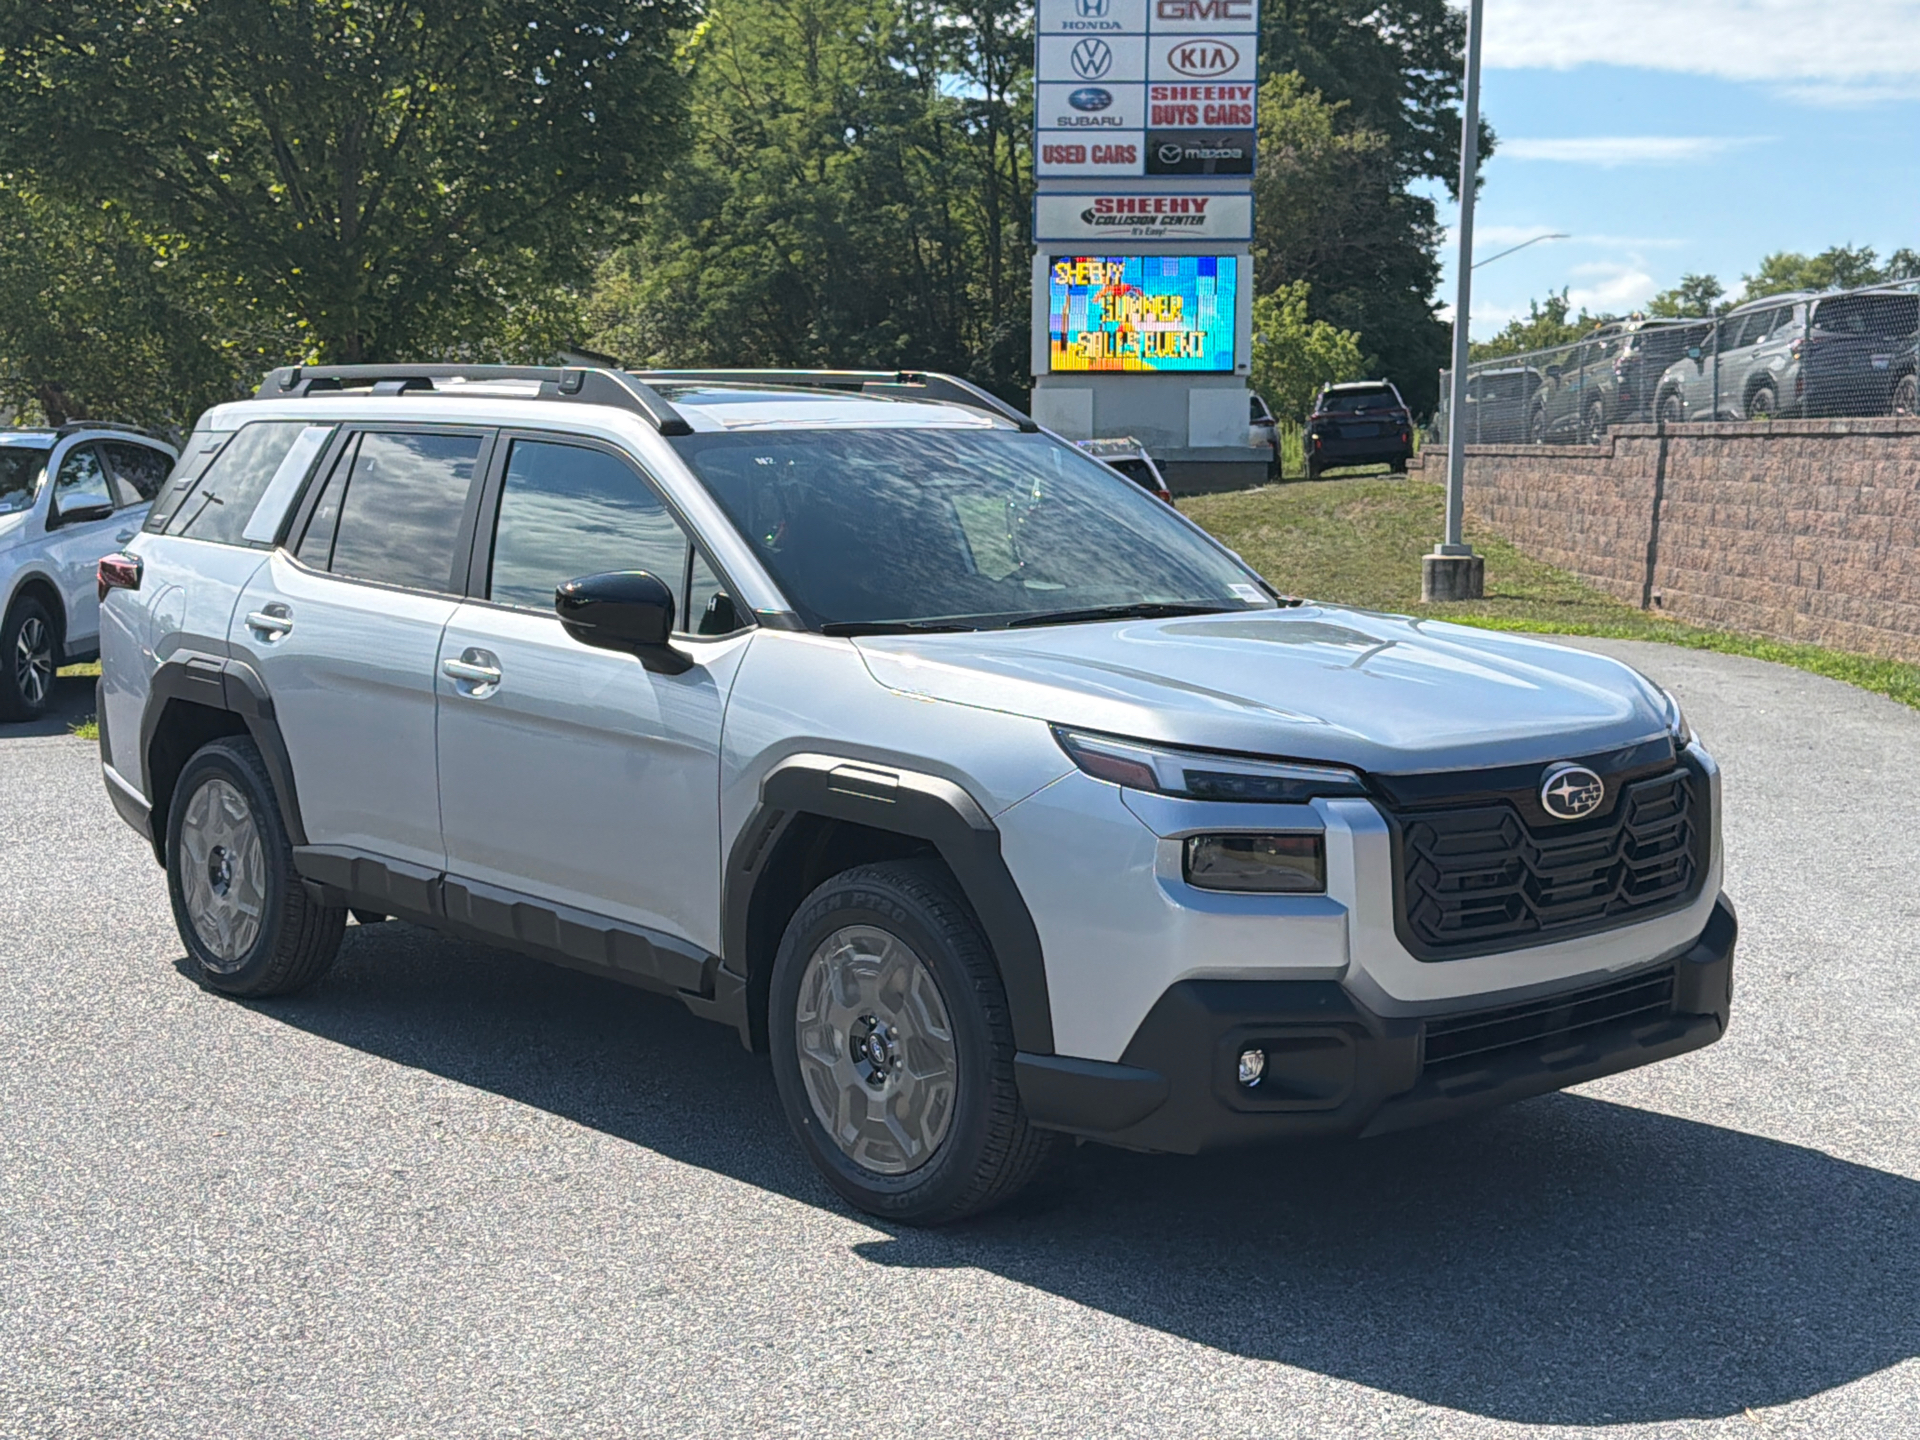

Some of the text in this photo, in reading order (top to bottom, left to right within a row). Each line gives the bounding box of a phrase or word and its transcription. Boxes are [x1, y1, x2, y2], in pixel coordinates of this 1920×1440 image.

[1157, 0, 1252, 20] GMC
[1062, 21, 1122, 30] HONDA
[1180, 49, 1227, 69] KIA
[1151, 87, 1252, 101] SHEEHY
[1057, 116, 1123, 126] SUBARU
[1151, 105, 1252, 126] BUYS CARS
[1042, 145, 1137, 164] USED CARS
[1184, 148, 1243, 159] mazda
[1094, 198, 1209, 214] SHEEHY
[1095, 215, 1206, 226] COLLISION CENTER
